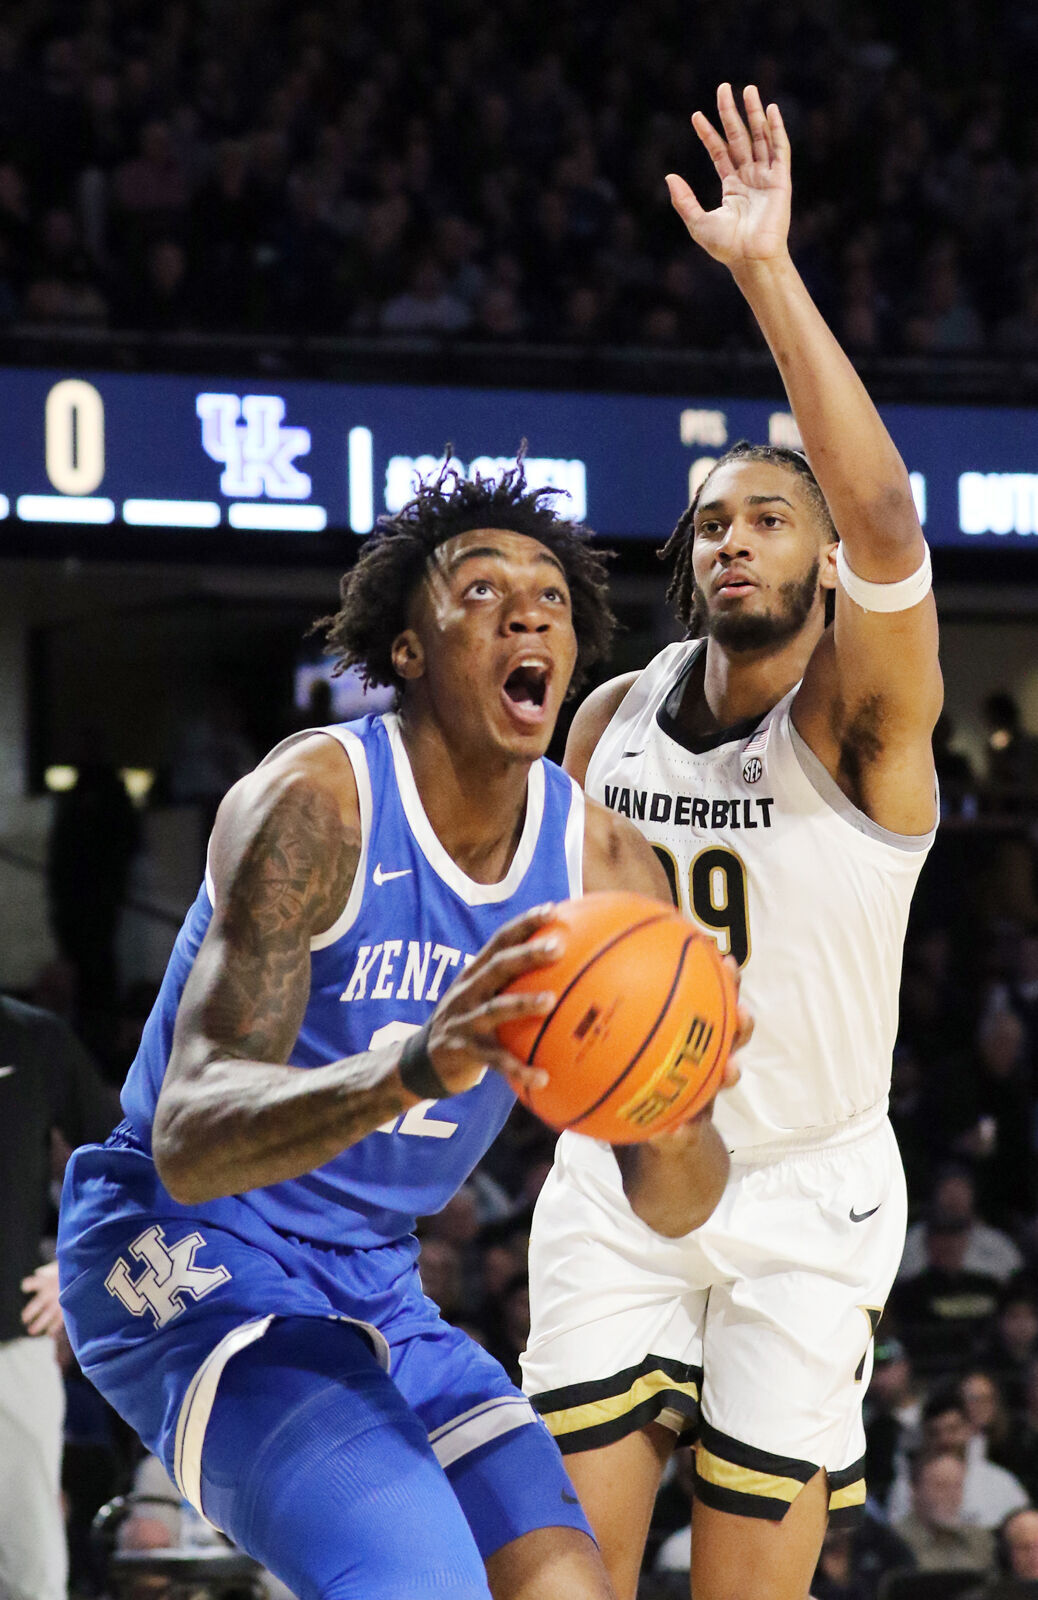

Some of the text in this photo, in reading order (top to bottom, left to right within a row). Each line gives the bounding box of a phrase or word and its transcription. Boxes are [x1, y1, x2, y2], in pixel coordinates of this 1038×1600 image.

[46, 379, 104, 495] 0
[196, 393, 312, 499] UK
[604, 785, 774, 829] VANDERBILT
[744, 758, 762, 783] SEC
[649, 841, 752, 971] 9
[104, 1224, 232, 1330] UK
